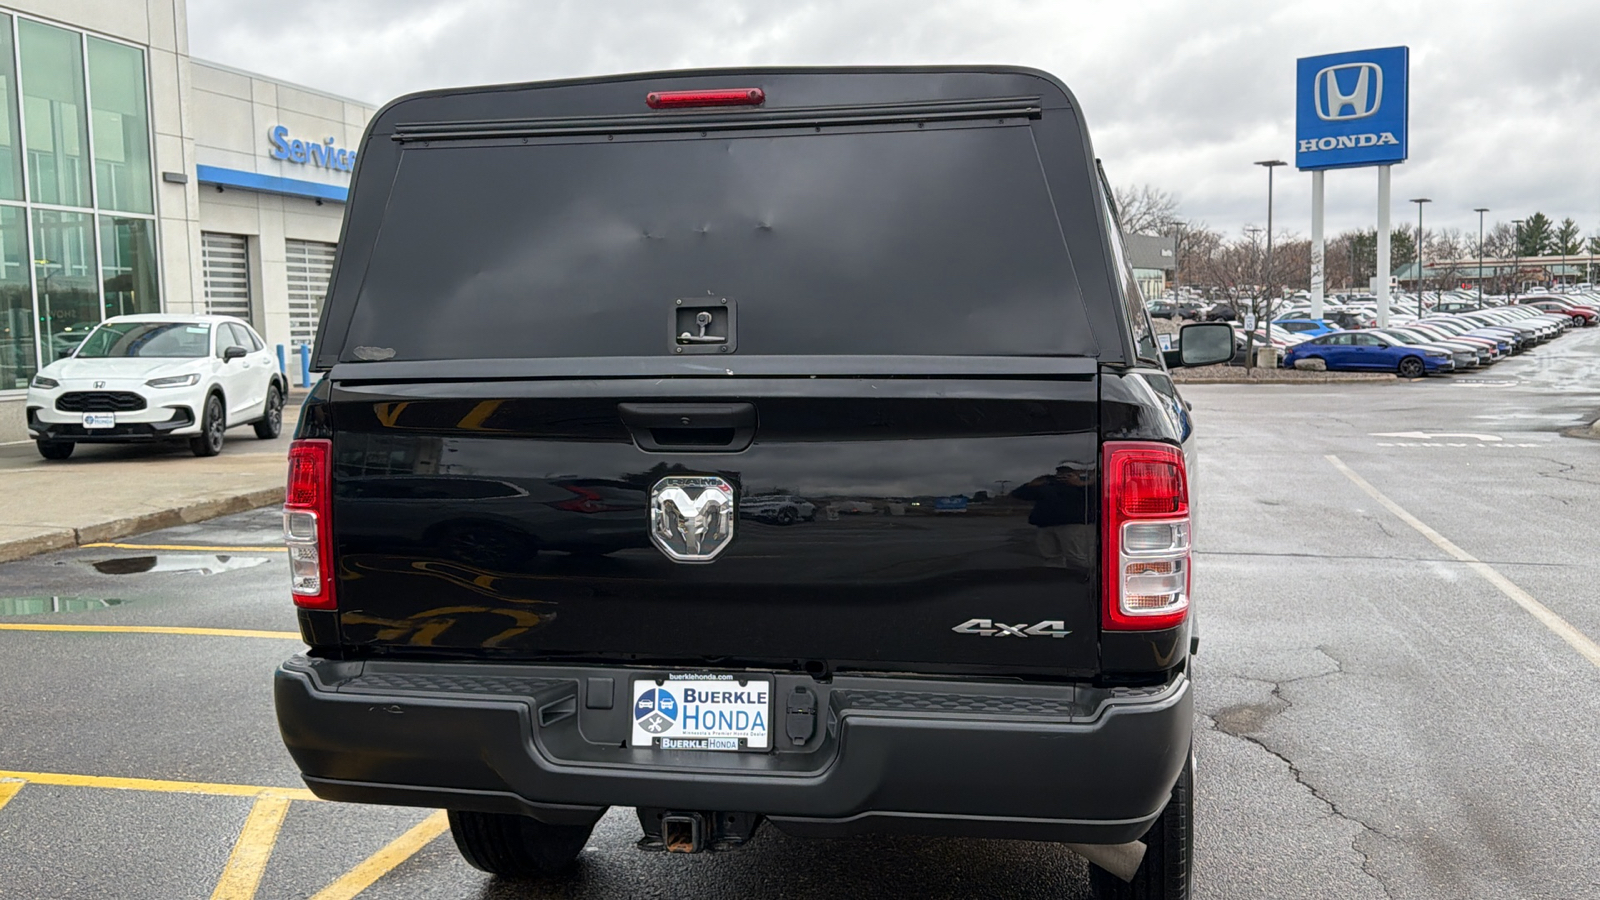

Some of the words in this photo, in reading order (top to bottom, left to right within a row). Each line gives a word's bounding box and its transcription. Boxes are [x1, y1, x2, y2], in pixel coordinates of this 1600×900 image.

[1298, 132, 1399, 152] HONDA
[683, 688, 767, 704] BUERKLE
[682, 705, 766, 731] HONDA
